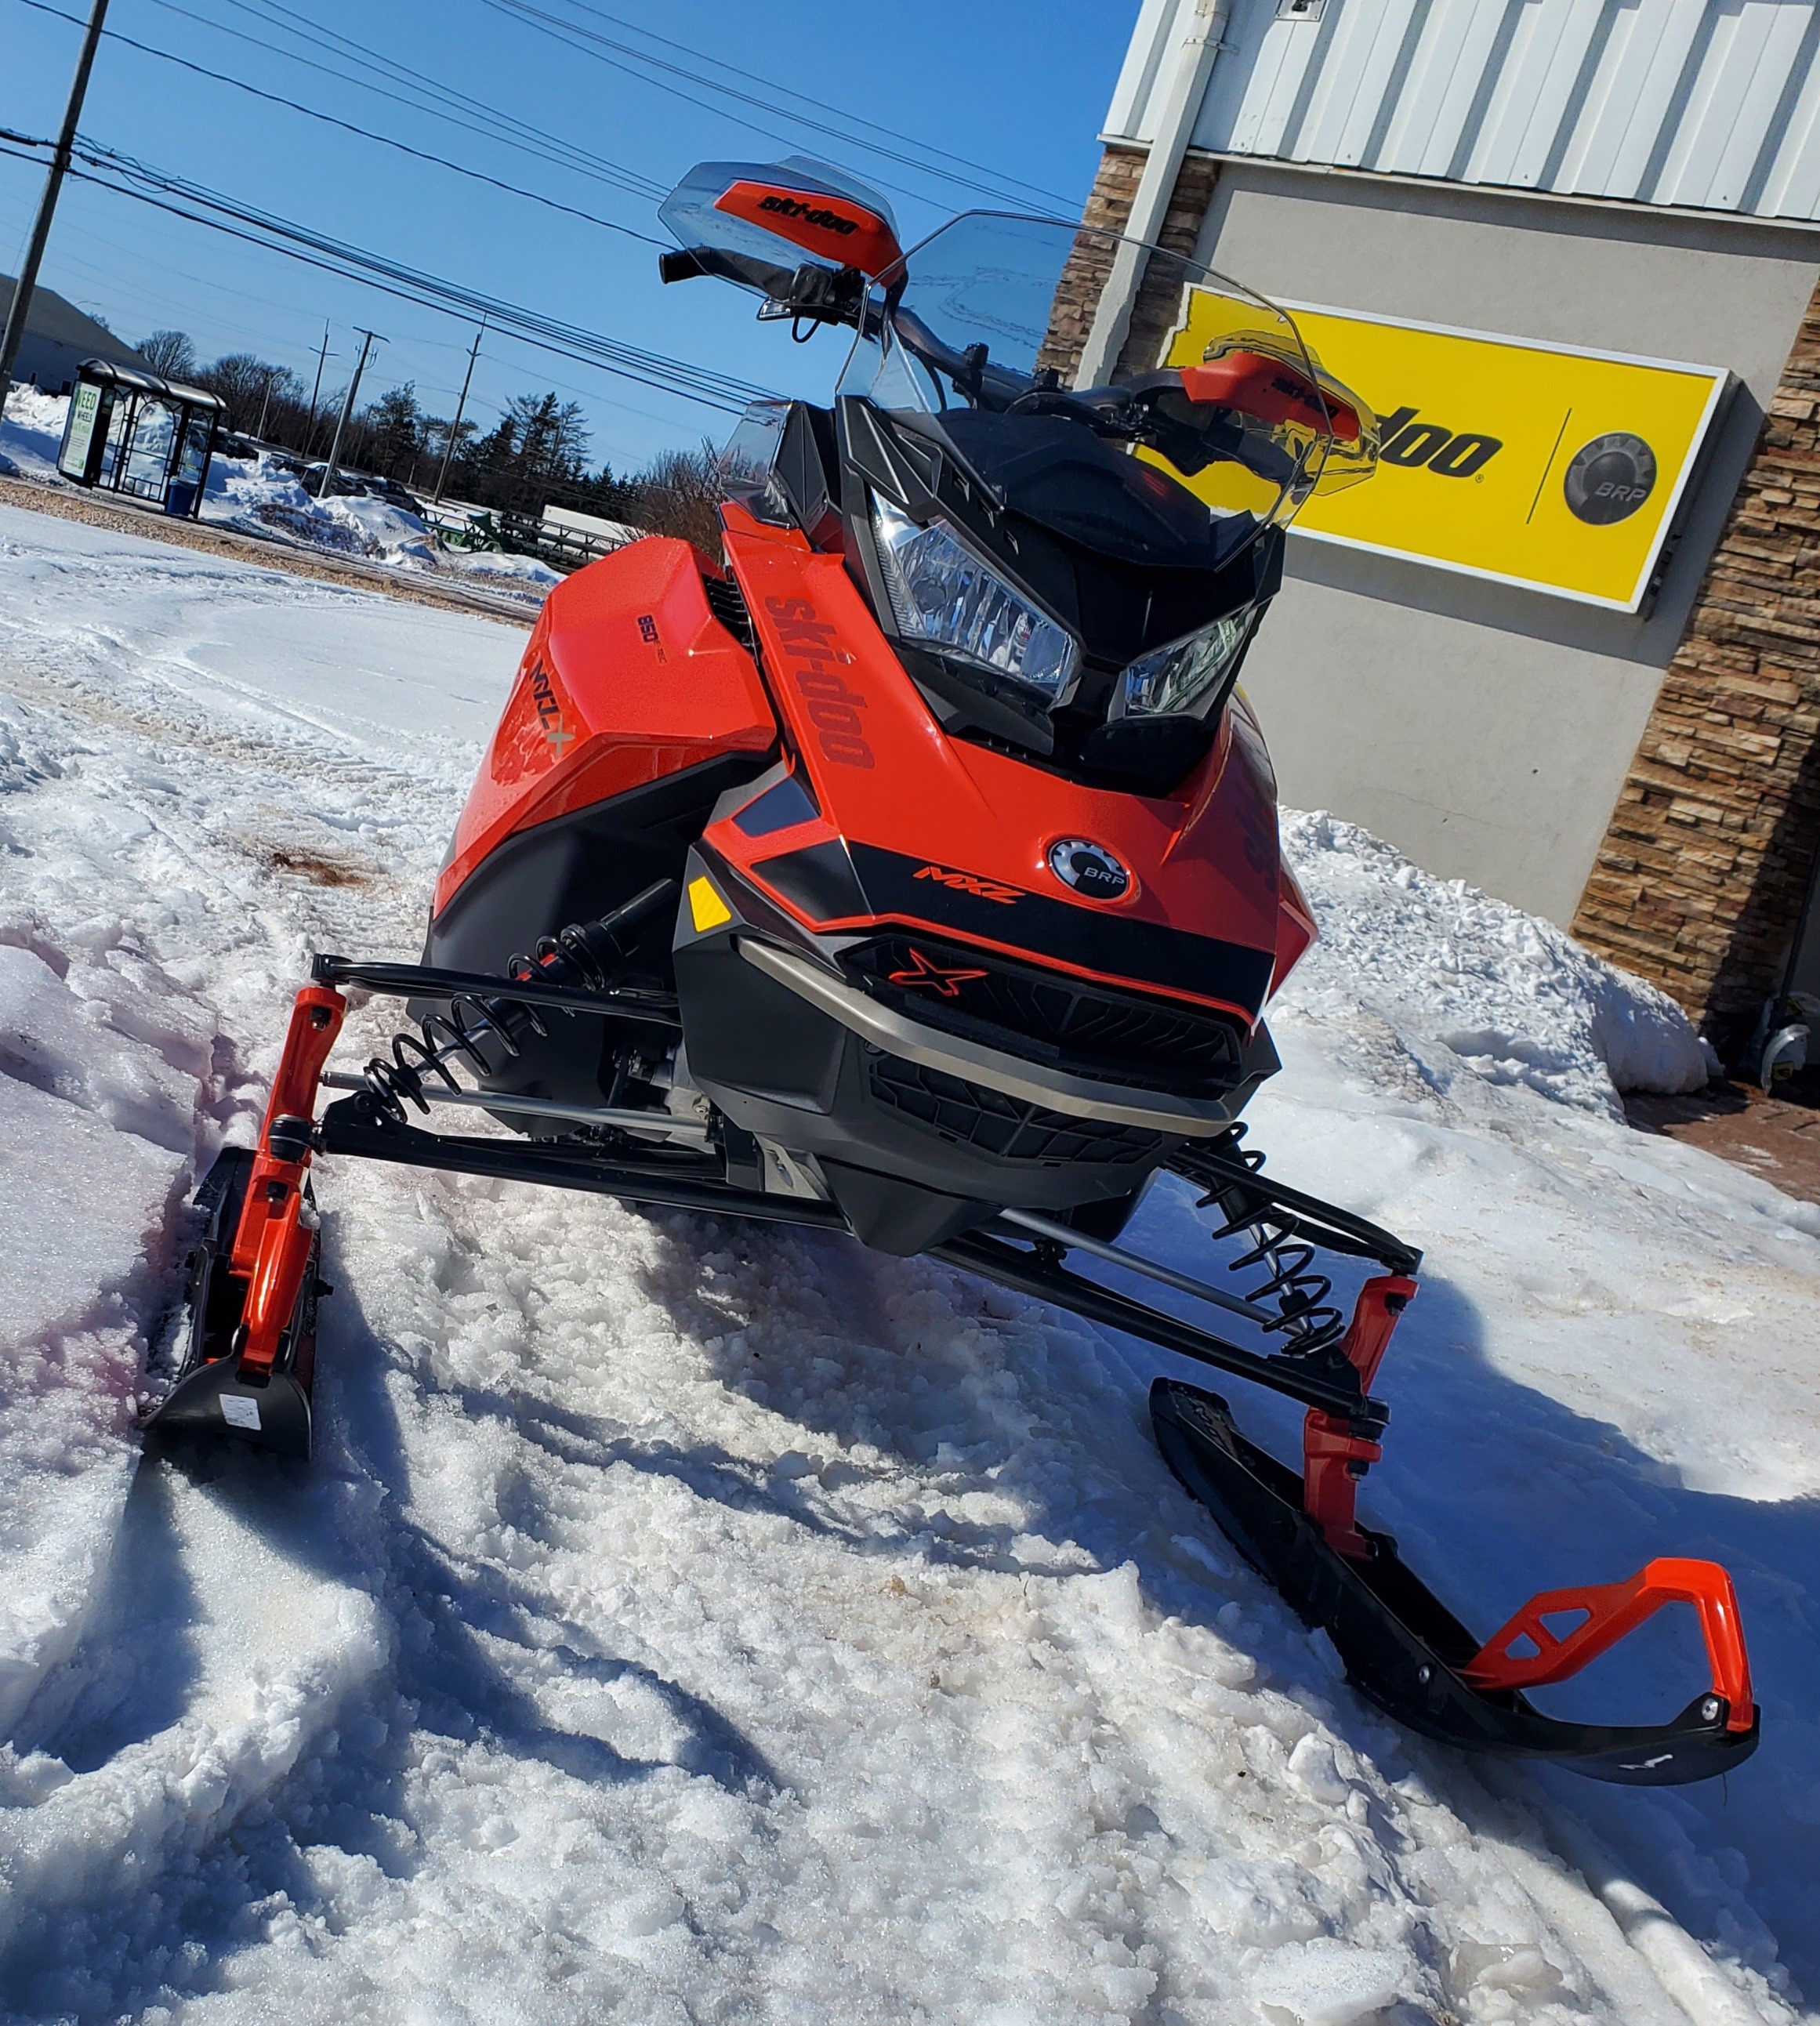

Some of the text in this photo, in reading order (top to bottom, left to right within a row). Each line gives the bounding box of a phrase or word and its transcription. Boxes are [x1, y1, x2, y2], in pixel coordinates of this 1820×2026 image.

[757, 195, 861, 235] ski-doo
[75, 387, 97, 411] NEED
[1594, 481, 1646, 502] BRP
[637, 614, 659, 643] 850
[765, 595, 876, 770] ski-doo
[912, 865, 1027, 904] MXZ
[1084, 866, 1125, 885] BRP
